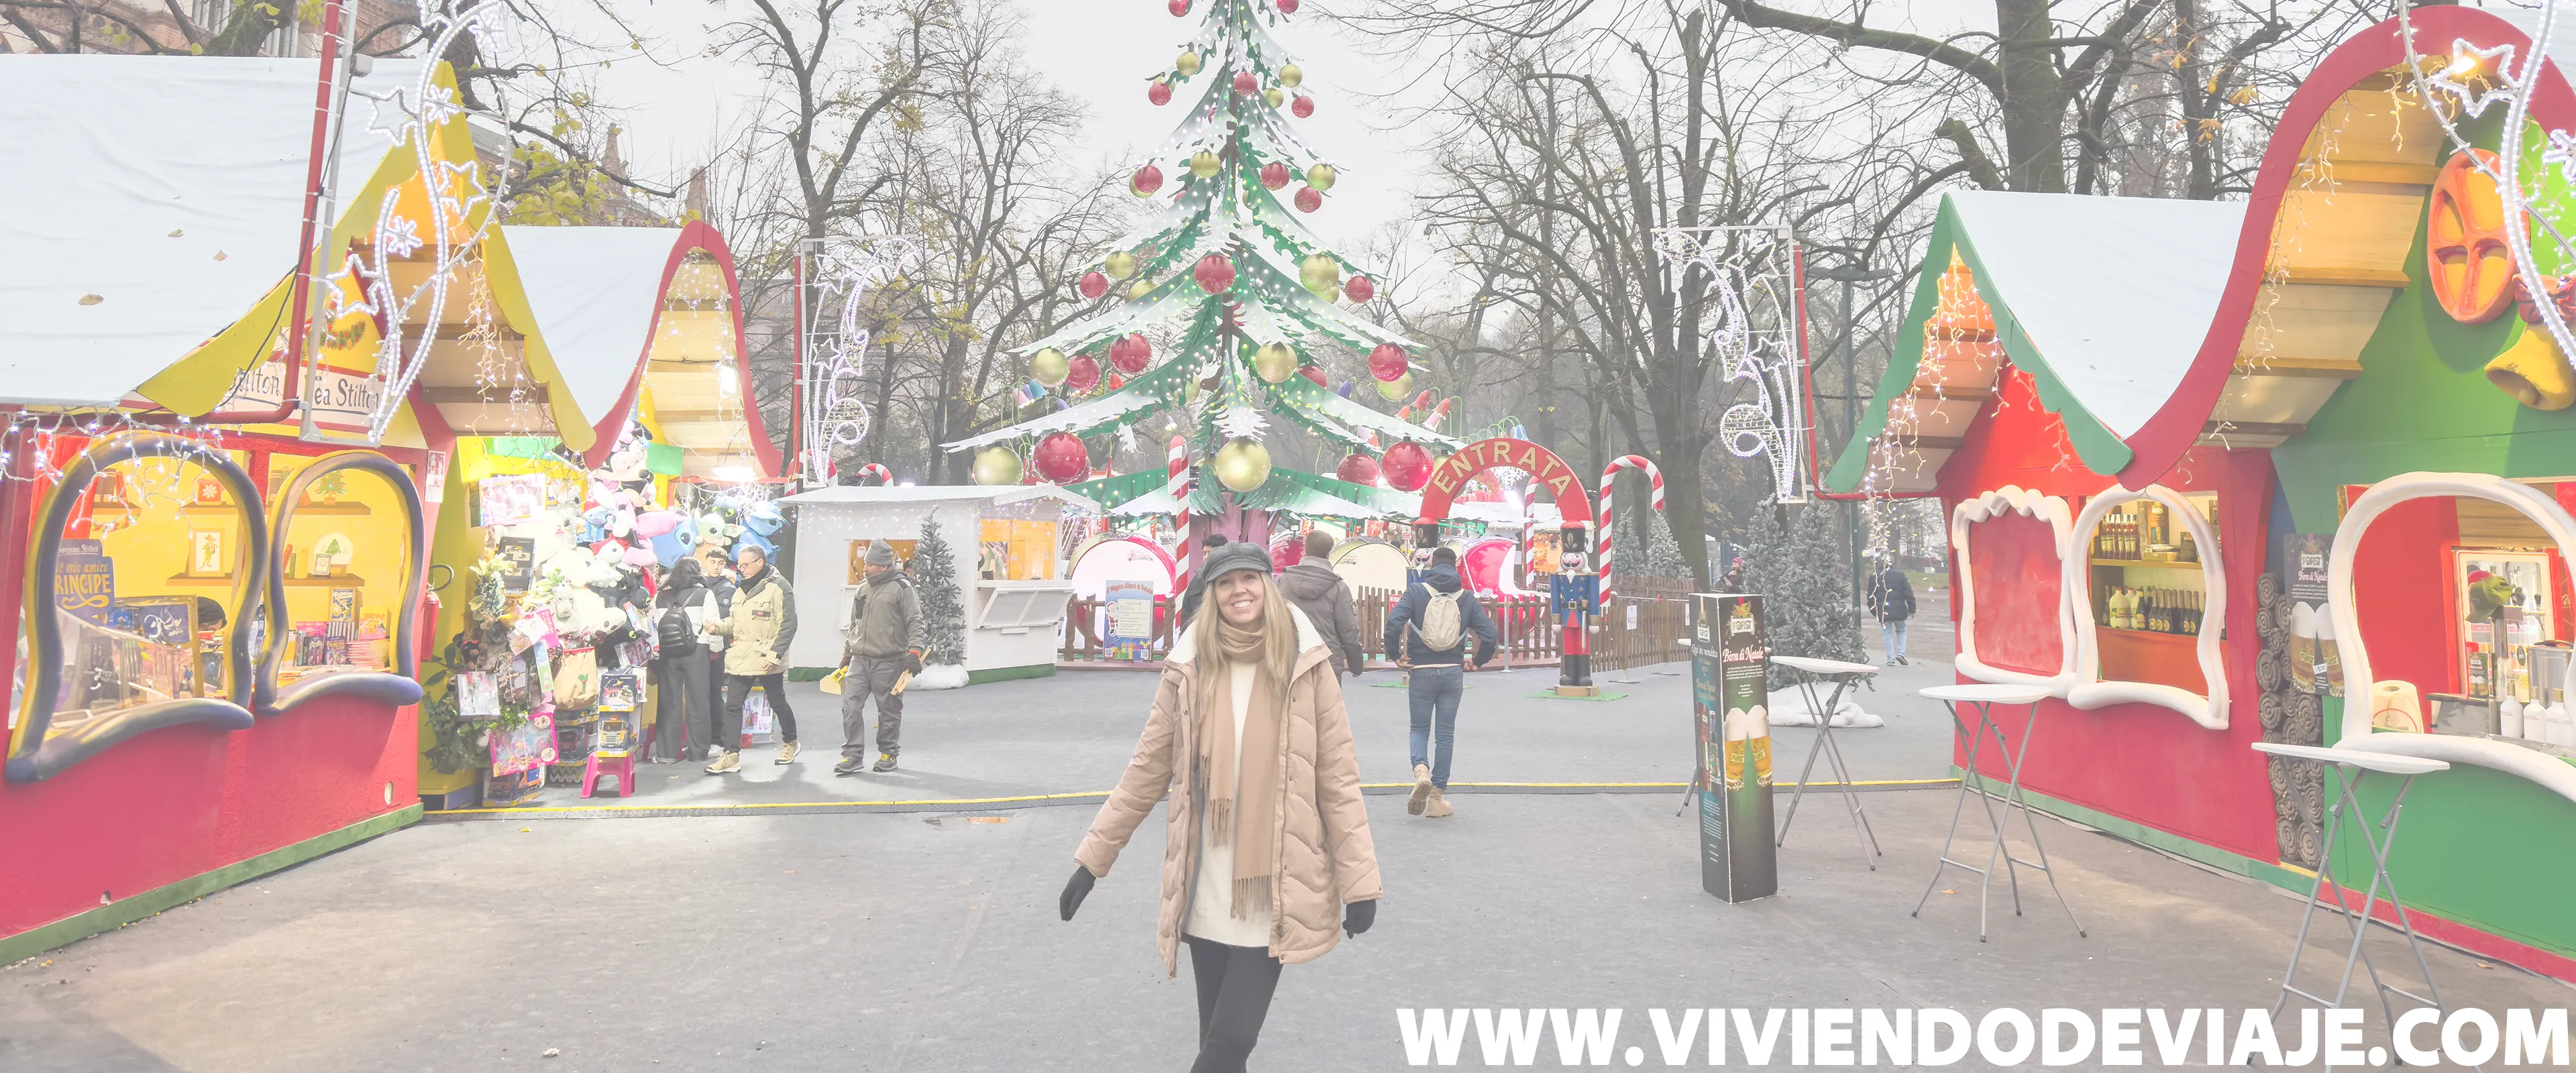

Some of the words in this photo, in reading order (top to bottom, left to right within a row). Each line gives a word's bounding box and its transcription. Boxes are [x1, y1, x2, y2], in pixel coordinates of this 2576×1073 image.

[1433, 441, 1572, 498] ENTRATA
[55, 573, 112, 596] RINCIPE
[1723, 648, 1738, 663] Birra
[1739, 647, 1745, 661] di
[1745, 644, 1764, 663] Natale
